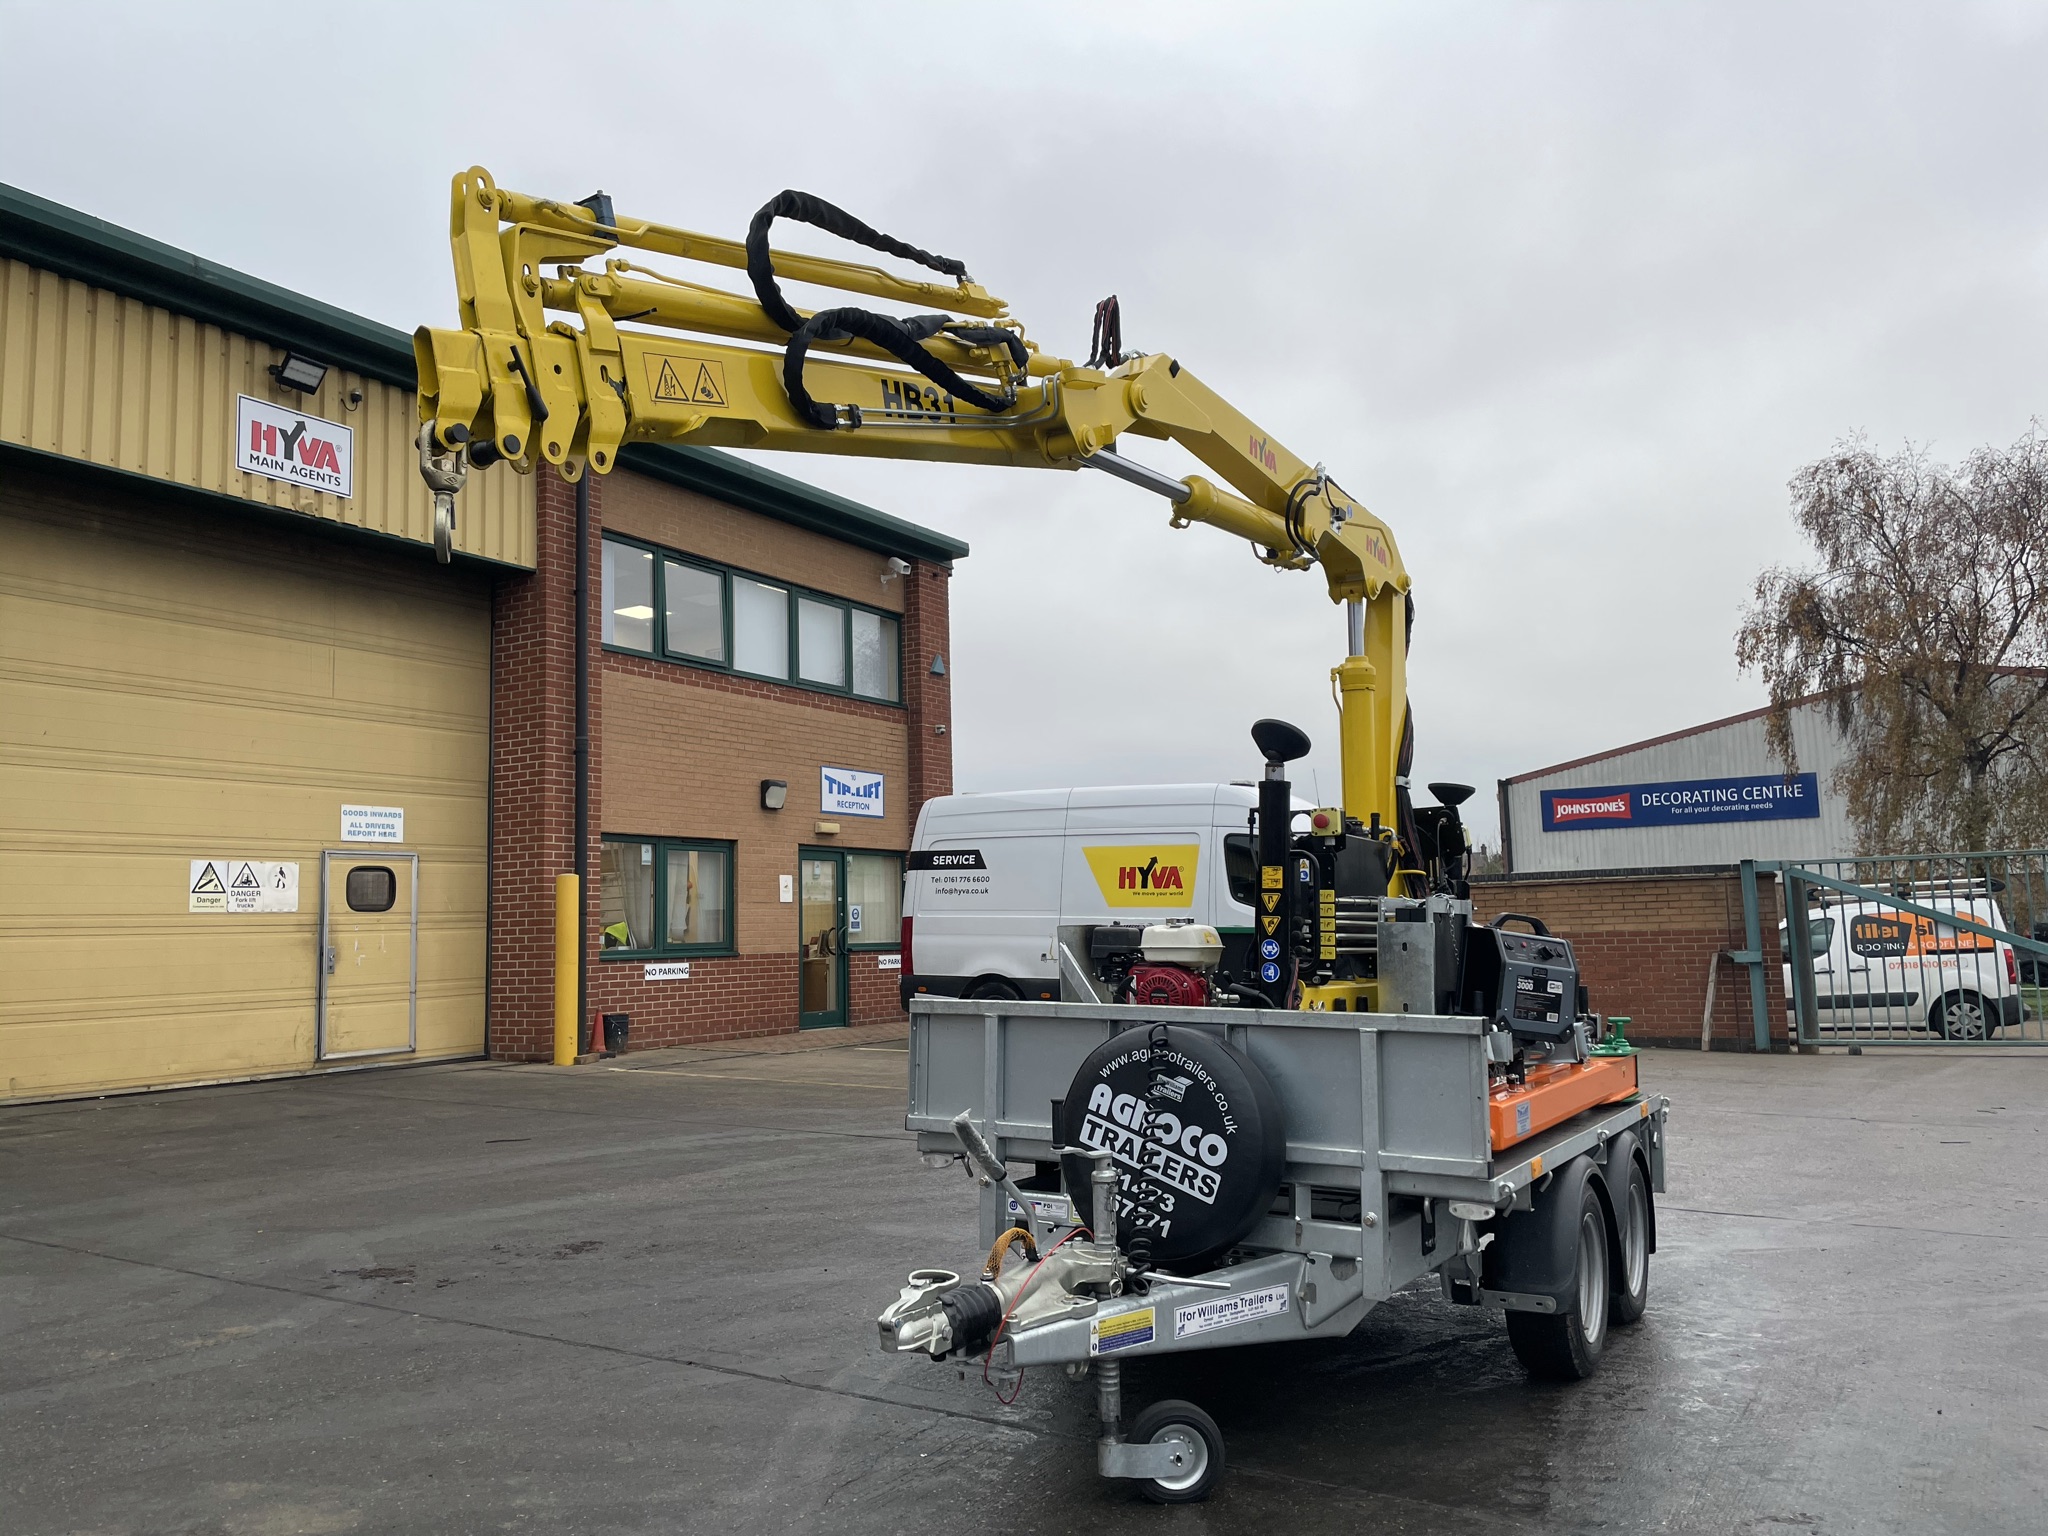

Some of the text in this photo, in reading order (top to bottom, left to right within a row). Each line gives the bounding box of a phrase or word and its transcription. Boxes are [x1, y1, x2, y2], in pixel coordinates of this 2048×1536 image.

[881, 379, 956, 423] HB31
[251, 420, 341, 474] HYVA
[1249, 434, 1277, 475] HYVA
[250, 453, 341, 486] MAIN AGENTS
[1366, 534, 1387, 568] HYVA
[837, 800, 870, 810] RECEPTION
[1641, 784, 1803, 806] DECORATING CENTRE
[1556, 799, 1626, 818] JOHNSTONE'S
[1684, 805, 1693, 813] all
[1694, 806, 1710, 814] your
[1711, 803, 1750, 812] decorating
[1751, 801, 1773, 809] needs
[932, 855, 976, 865] SERVICE
[1119, 856, 1183, 889] HYVA
[935, 887, 989, 895] info@hyva.co.uk
[645, 967, 689, 976] NO PARKING
[1517, 981, 1534, 990] 3000
[1180, 1311, 1197, 1323] Ifor
[1197, 1302, 1239, 1318] Williams
[1240, 1293, 1273, 1308] Trailers
